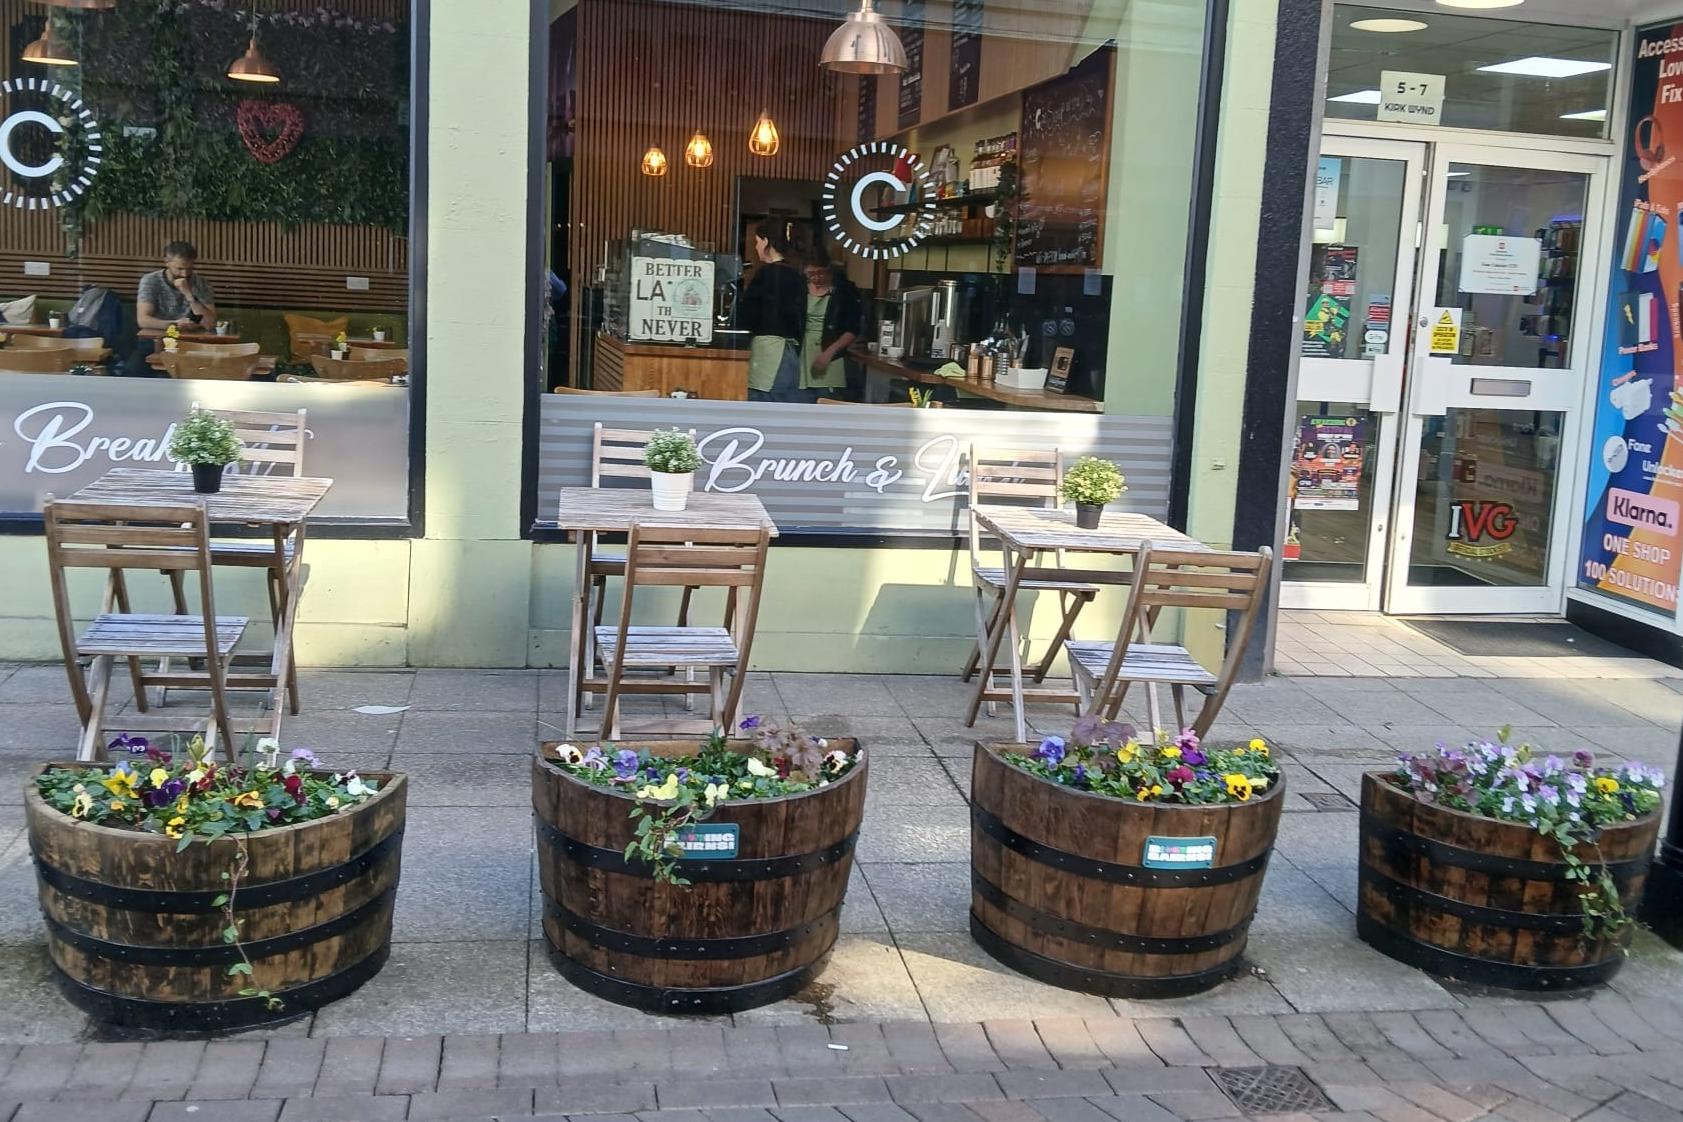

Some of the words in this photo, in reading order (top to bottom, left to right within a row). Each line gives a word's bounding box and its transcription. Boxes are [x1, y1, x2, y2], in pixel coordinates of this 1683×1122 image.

[1397, 82, 1406, 94] 5
[1420, 84, 1428, 96] 7
[1384, 102, 1407, 112] KIRK
[0, 110, 64, 177] C
[851, 171, 907, 231] C
[645, 262, 702, 278] BETTER
[656, 305, 672, 316] TH
[641, 318, 702, 338] NEVER
[699, 427, 858, 493] Brunch
[866, 455, 902, 493] &
[1447, 500, 1519, 541] IVG
[1603, 533, 1630, 556] ONE
[1632, 540, 1671, 565] SHOP
[1584, 559, 1606, 581] 100
[1608, 567, 1680, 602] SOLUTION
